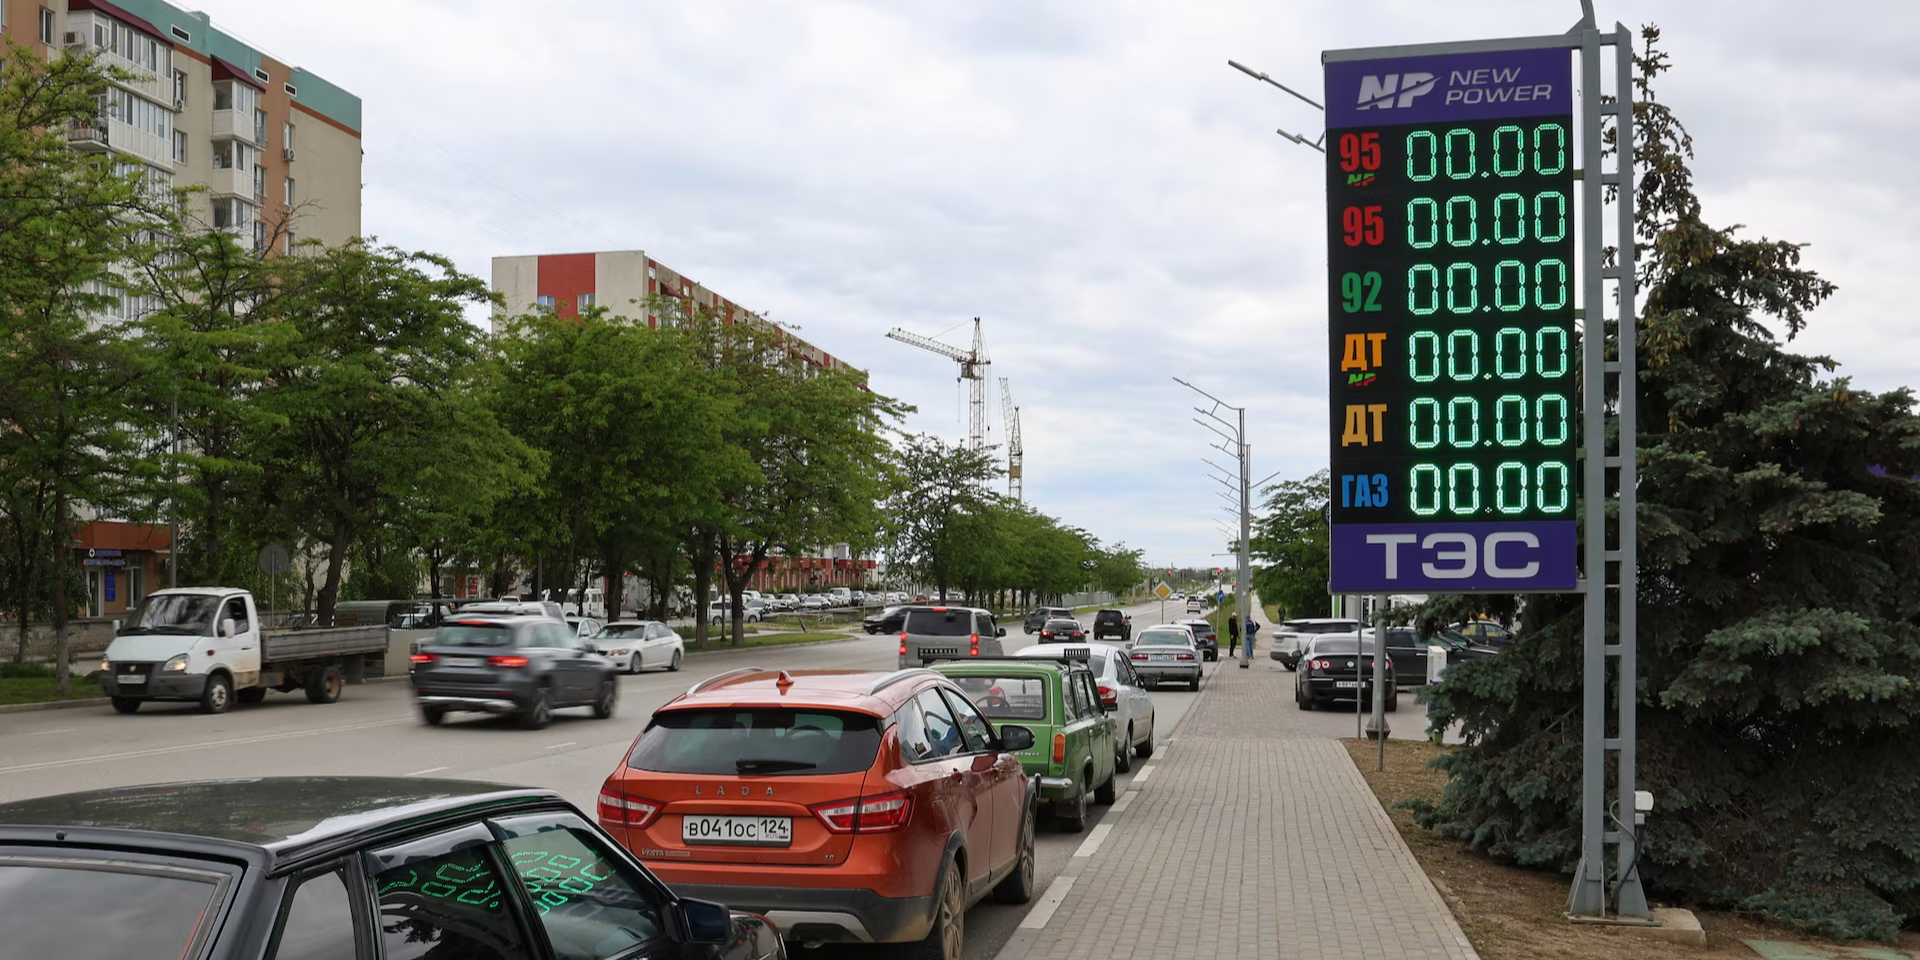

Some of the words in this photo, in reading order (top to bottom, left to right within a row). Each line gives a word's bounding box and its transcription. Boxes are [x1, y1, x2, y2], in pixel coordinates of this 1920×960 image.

[1356, 72, 1441, 110] NP
[1445, 84, 1552, 105] POWER
[1449, 67, 1521, 86] NEW
[1339, 132, 1382, 171] 95
[1406, 123, 1564, 182] 00.00
[1342, 205, 1384, 247] 95
[1407, 191, 1566, 249] 00.00
[1341, 271, 1382, 313] 92
[1408, 258, 1566, 315] 00.00
[1341, 332, 1386, 371] ДТ
[1409, 326, 1567, 382] 00.00
[1341, 404, 1387, 447] ДТ
[1409, 394, 1567, 448] 00.00
[1341, 473, 1389, 508] ГАЗ
[1410, 461, 1568, 515] 00.00
[1366, 531, 1540, 579] ТЭС
[695, 785, 774, 796] LADA
[760, 819, 787, 834] 124
